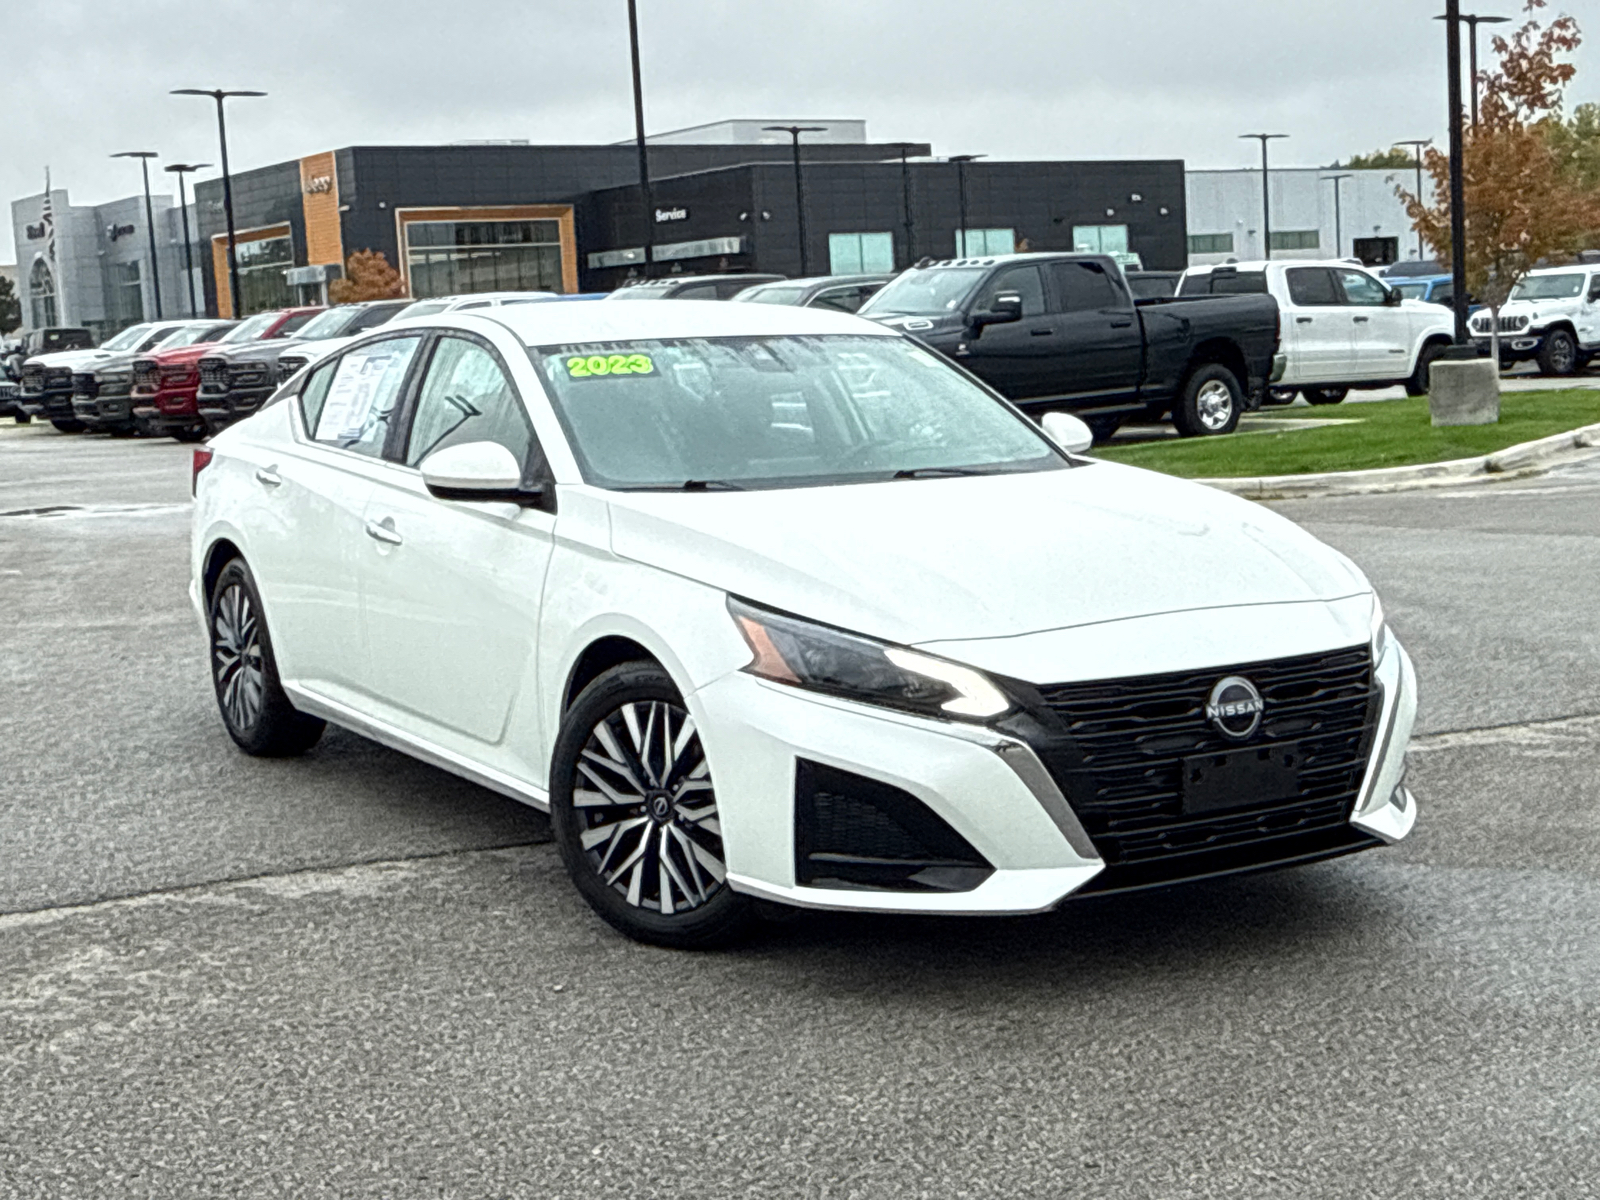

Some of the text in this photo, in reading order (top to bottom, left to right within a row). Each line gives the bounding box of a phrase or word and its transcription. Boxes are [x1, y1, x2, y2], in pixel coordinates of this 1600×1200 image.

[655, 207, 686, 223] Service
[567, 354, 654, 378] 2023
[1206, 699, 1264, 718] NISSAN
